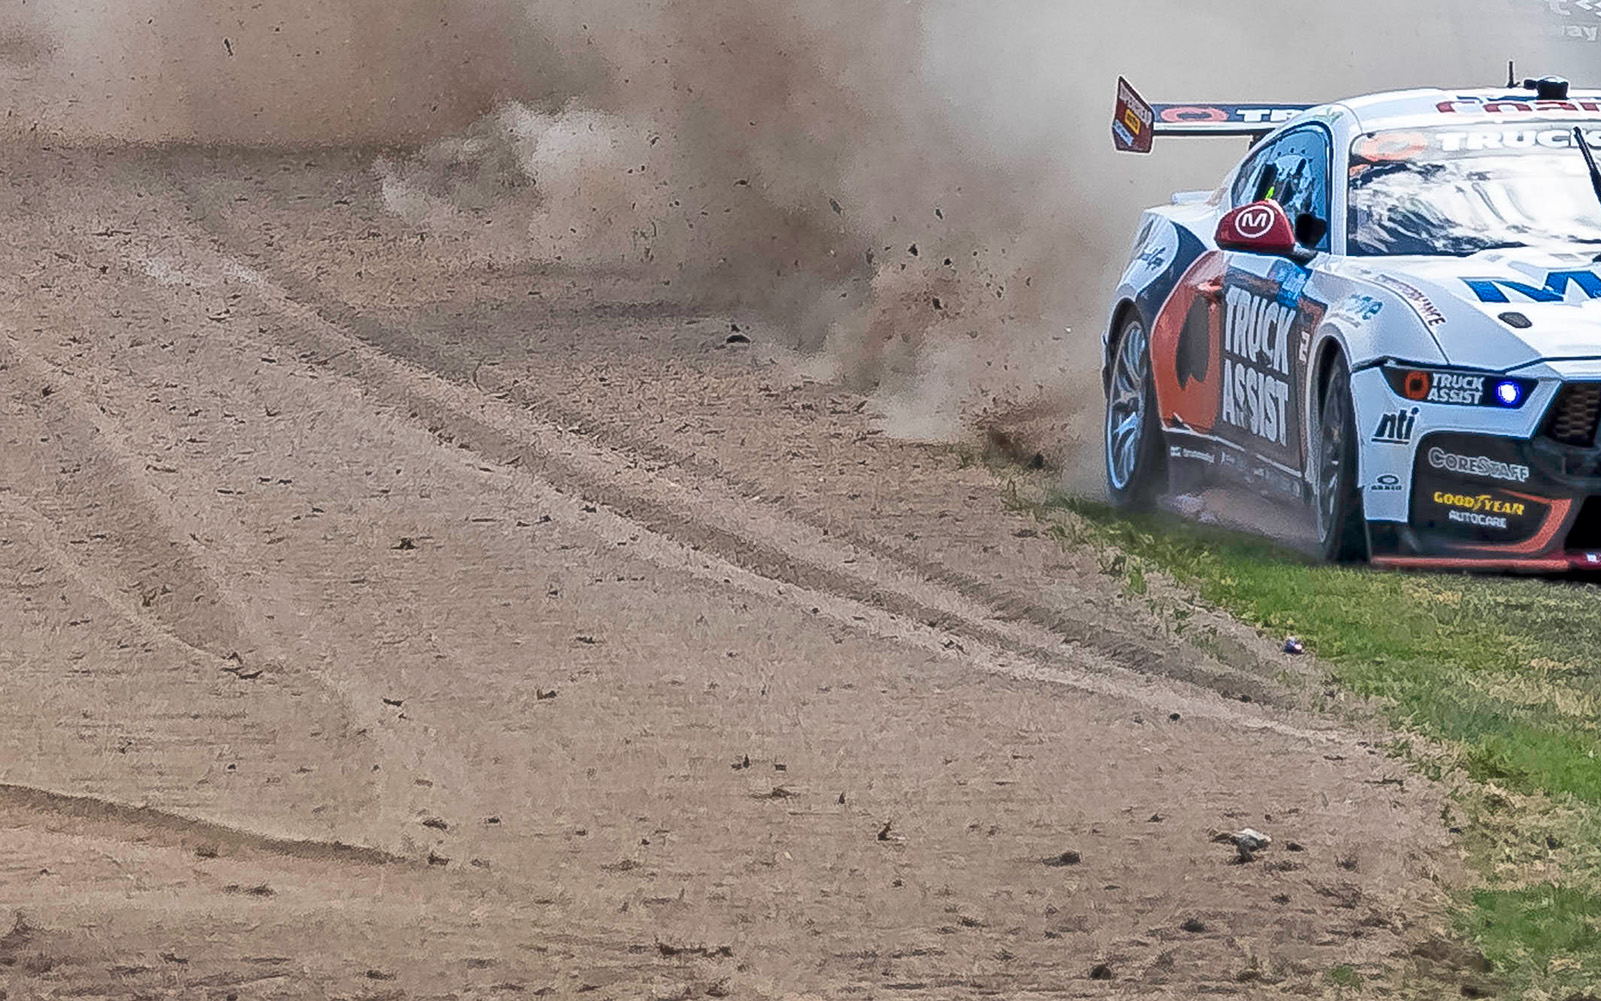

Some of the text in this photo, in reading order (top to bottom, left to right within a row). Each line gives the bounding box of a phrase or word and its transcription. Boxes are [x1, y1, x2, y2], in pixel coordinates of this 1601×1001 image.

[1225, 286, 1296, 376] TRUCK
[1431, 372, 1486, 391] TRUCK
[1222, 358, 1290, 447] ASSIST
[1426, 387, 1484, 405] ASSIST
[1370, 406, 1420, 445] nti
[1433, 490, 1526, 517] GOODYEAR
[1448, 508, 1508, 530] AUTOCARE
